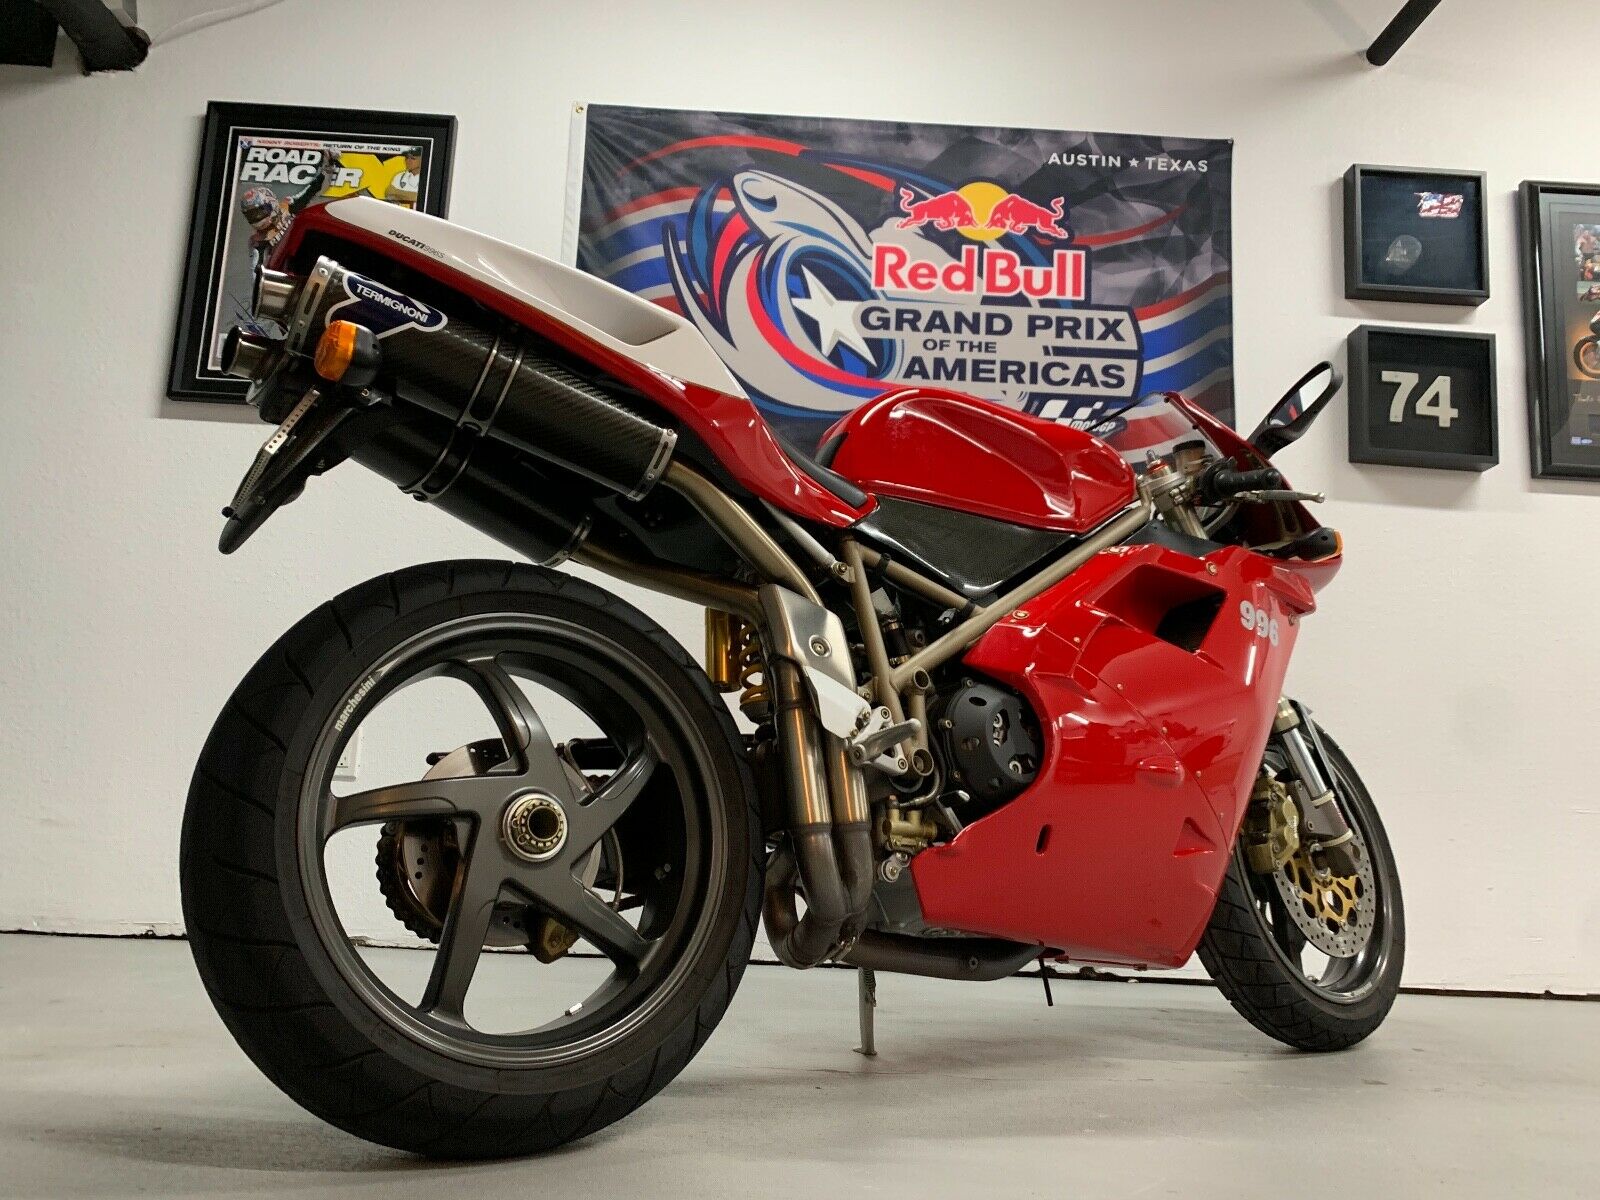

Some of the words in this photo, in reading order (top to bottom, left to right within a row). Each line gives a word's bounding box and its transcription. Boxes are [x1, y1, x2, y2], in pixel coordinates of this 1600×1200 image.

[246, 147, 322, 164] ROAD
[1048, 152, 1121, 168] AUSTIN
[1145, 156, 1208, 173] TEXAS
[871, 244, 978, 294] Red
[982, 248, 1086, 301] Bull
[356, 283, 429, 323] TERMIGNONI
[860, 306, 1013, 336] GRAND
[1027, 314, 1126, 341] PRIX
[922, 338, 950, 351] OF
[956, 340, 997, 353] THE
[902, 355, 1126, 389] AMERICAS
[1381, 370, 1459, 428] 74
[1240, 600, 1279, 647] 996
[334, 675, 377, 732] marchesini
